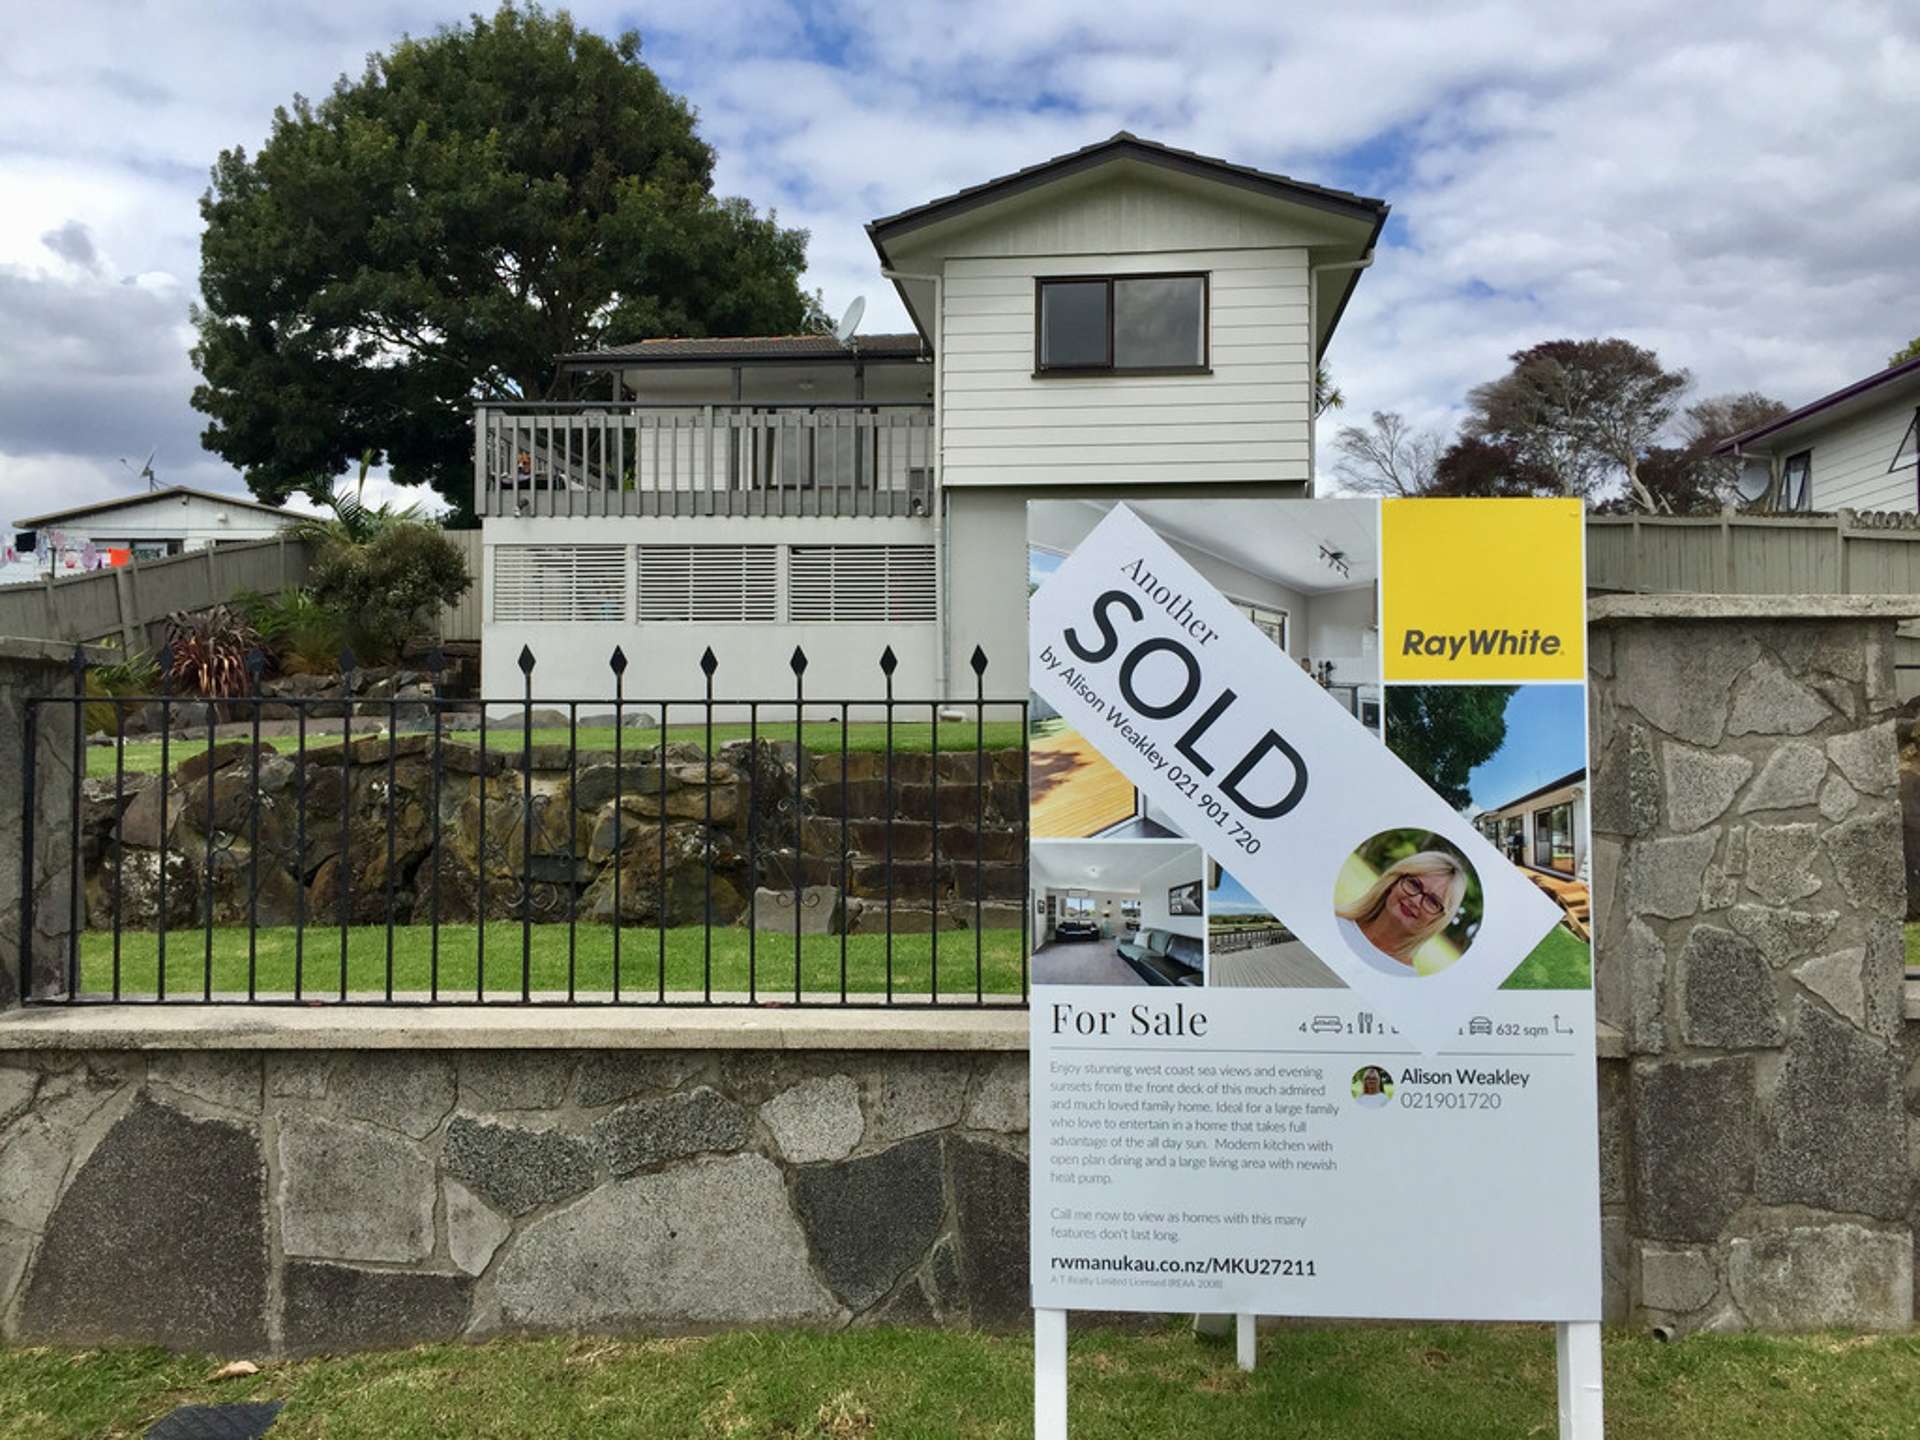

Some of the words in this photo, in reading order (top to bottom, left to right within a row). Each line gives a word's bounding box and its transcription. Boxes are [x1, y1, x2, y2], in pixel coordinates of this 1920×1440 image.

[1121, 558, 1219, 646] Another
[1063, 590, 1308, 820] SOLD
[1039, 646, 1062, 671] by
[1059, 667, 1106, 713] Alison
[1105, 705, 1169, 771] Weakley
[1167, 766, 1200, 800] 021
[1197, 794, 1231, 828] 901
[1227, 821, 1262, 855] 720
[1051, 1003, 1116, 1035] For
[1131, 1002, 1208, 1037] Sale
[1496, 1024, 1521, 1036] 632
[1523, 1027, 1549, 1038] sqm
[1050, 1061, 1081, 1075] Enjoy
[1084, 1064, 1133, 1077] stunning
[1135, 1065, 1161, 1076] west
[1164, 1066, 1195, 1076] coast
[1198, 1068, 1217, 1077] sea
[1220, 1066, 1251, 1077] views
[1254, 1065, 1276, 1077] and
[1278, 1067, 1323, 1080] evening
[1401, 1068, 1452, 1085] Alison
[1456, 1068, 1530, 1088] Weakley
[1095, 1081, 1121, 1093] from
[1124, 1082, 1143, 1094] the
[1146, 1082, 1174, 1094] front
[1177, 1082, 1204, 1095] deck
[1206, 1083, 1219, 1095] of
[1221, 1083, 1242, 1095] this
[1245, 1084, 1277, 1096] much
[1279, 1084, 1326, 1097] admired
[1050, 1099, 1072, 1111] and
[1074, 1100, 1106, 1112] much
[1108, 1099, 1139, 1112] loved
[1142, 1100, 1175, 1114] family
[1216, 1102, 1243, 1114] Ideal
[1246, 1102, 1263, 1114] for
[1275, 1102, 1303, 1117] large
[1306, 1103, 1340, 1117] family
[1401, 1092, 1502, 1110] 021901720
[1050, 1117, 1076, 1129] who
[1078, 1117, 1102, 1129] love
[1104, 1118, 1117, 1130] to
[1119, 1118, 1170, 1131] entertain
[1172, 1119, 1183, 1131] in
[1195, 1119, 1228, 1132] home
[1231, 1120, 1253, 1133] that
[1256, 1120, 1286, 1133] takes
[1289, 1121, 1307, 1134] full
[1050, 1135, 1108, 1150] advantage
[1111, 1136, 1123, 1149] of
[1126, 1136, 1145, 1148] the
[1147, 1137, 1159, 1149] all
[1162, 1137, 1183, 1151] day
[1215, 1137, 1261, 1151] Modern
[1263, 1138, 1306, 1152] kitchen
[1308, 1139, 1334, 1153] with
[1050, 1155, 1080, 1168] open
[1082, 1154, 1106, 1167] plan
[1108, 1154, 1143, 1170] dining
[1145, 1155, 1167, 1168] and
[1179, 1155, 1206, 1171] large
[1209, 1156, 1239, 1172] living
[1241, 1160, 1266, 1170] area
[1268, 1158, 1294, 1170] with
[1297, 1159, 1338, 1172] newish
[1050, 1207, 1072, 1221] Call
[1074, 1210, 1093, 1221] me
[1095, 1210, 1121, 1222] now
[1123, 1210, 1136, 1222] to
[1138, 1210, 1166, 1223] view
[1168, 1212, 1181, 1223] as
[1182, 1211, 1222, 1224] homes
[1223, 1212, 1249, 1225] with
[1251, 1212, 1272, 1225] this
[1274, 1214, 1307, 1228] many
[1050, 1227, 1096, 1240] features
[1131, 1229, 1151, 1241] last
[1051, 1255, 1317, 1277] rwmanukau.co.nz/MKU27211
